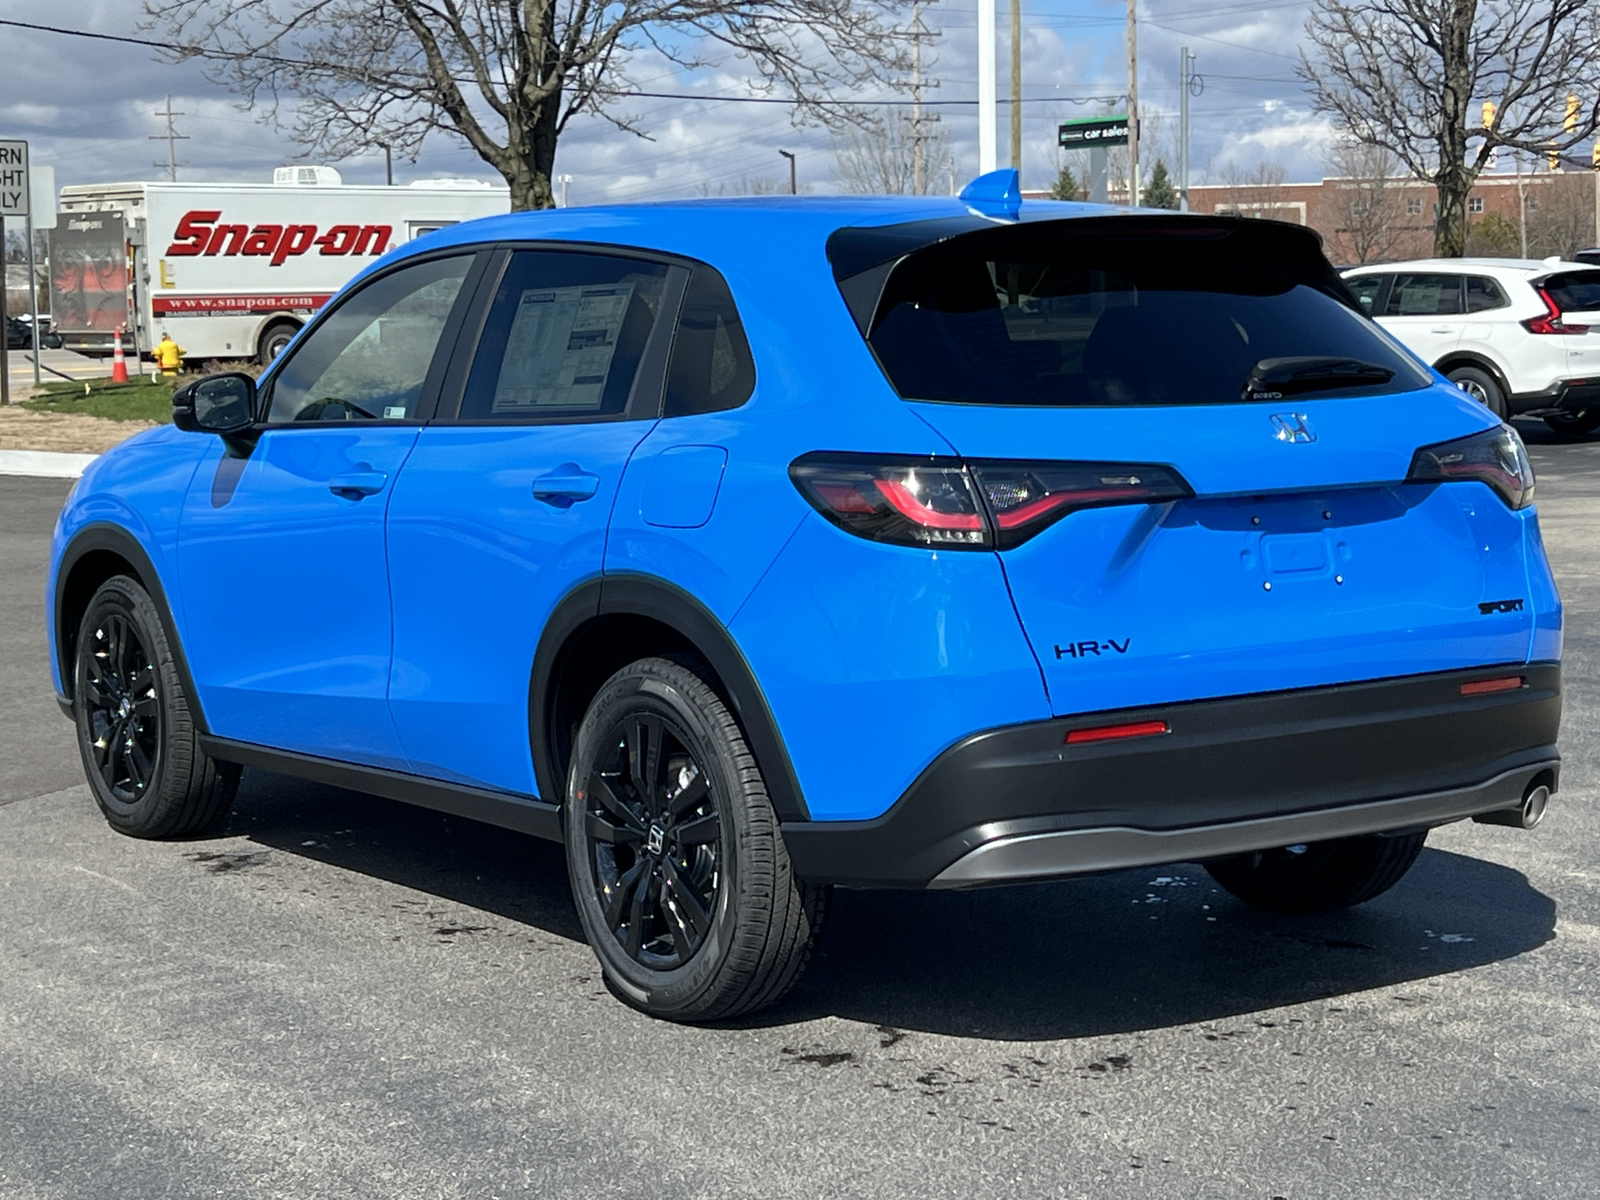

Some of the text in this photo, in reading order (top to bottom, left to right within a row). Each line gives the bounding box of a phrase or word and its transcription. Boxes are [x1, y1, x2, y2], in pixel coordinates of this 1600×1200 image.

[1084, 130, 1101, 139] car
[1102, 125, 1128, 138] sales
[0, 148, 22, 165] RN
[0, 169, 25, 187] HT
[0, 191, 22, 209] LY
[165, 211, 393, 267] Snap-on
[169, 297, 313, 309] www.snapon.com
[1054, 637, 1131, 660] HR-V
